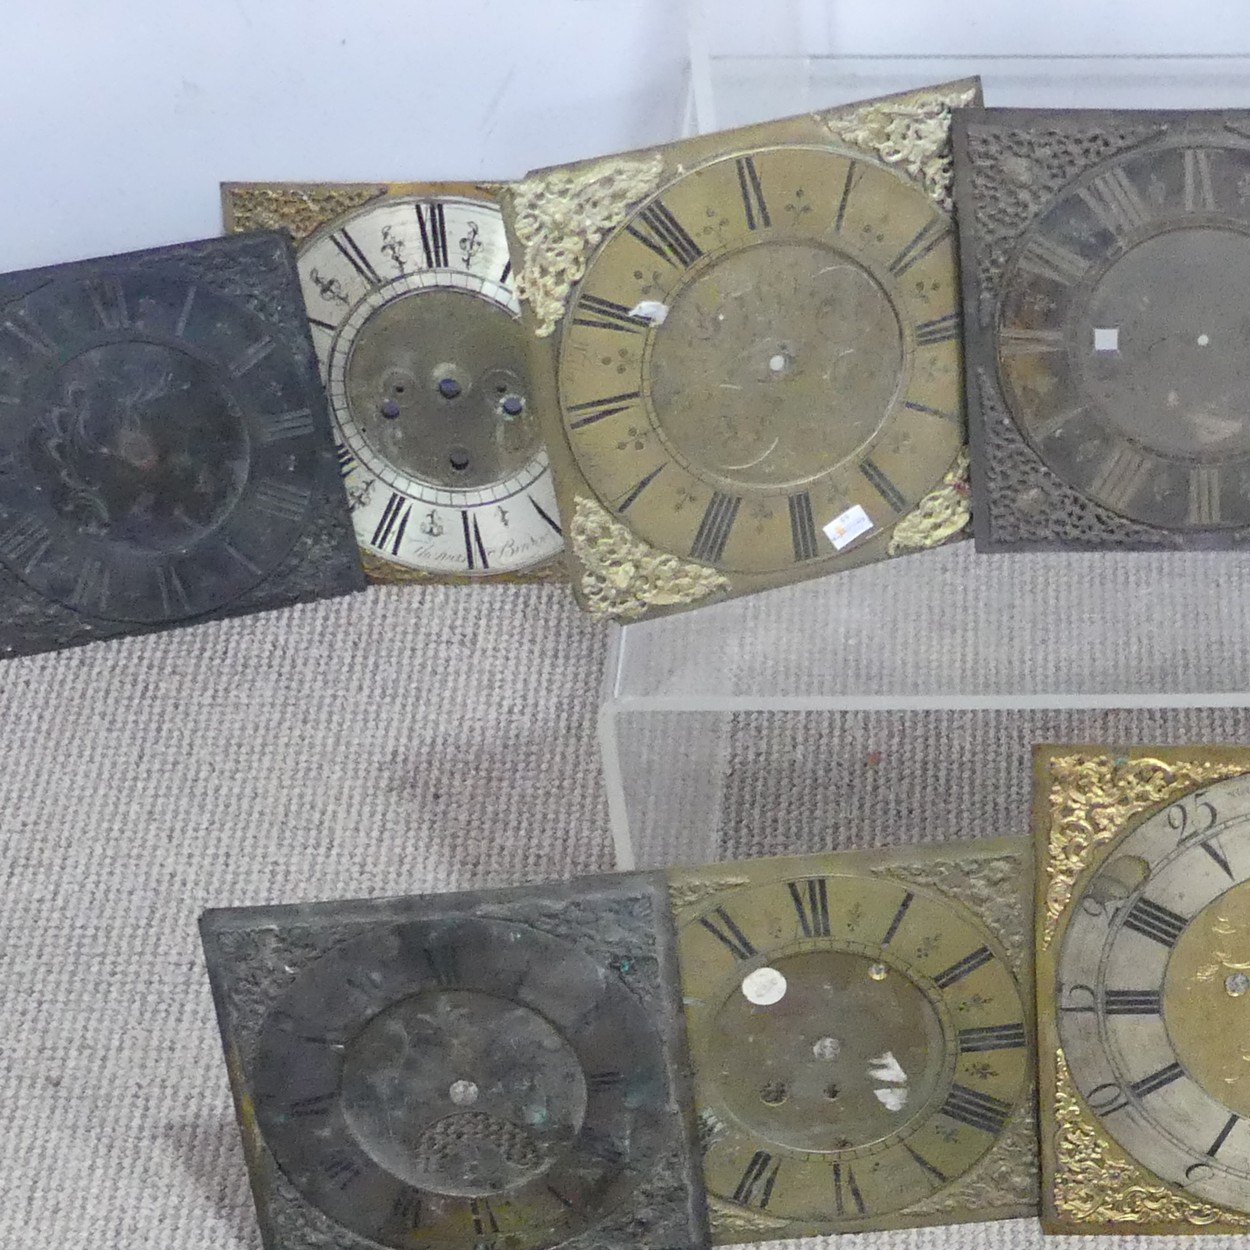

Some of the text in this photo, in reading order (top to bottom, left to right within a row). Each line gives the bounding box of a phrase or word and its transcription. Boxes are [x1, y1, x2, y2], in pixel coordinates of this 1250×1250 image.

[329, 226, 383, 286] XI
[415, 203, 450, 269] XII
[461, 510, 490, 570] VI
[1200, 836, 1237, 883] V
[787, 877, 832, 938] XII
[879, 891, 916, 950] I
[1119, 894, 1191, 950] IIII
[930, 942, 998, 990] II
[1104, 989, 1162, 1015] III
[957, 1021, 1028, 1053] III
[1128, 1060, 1188, 1100] II
[1204, 1112, 1241, 1159] I
